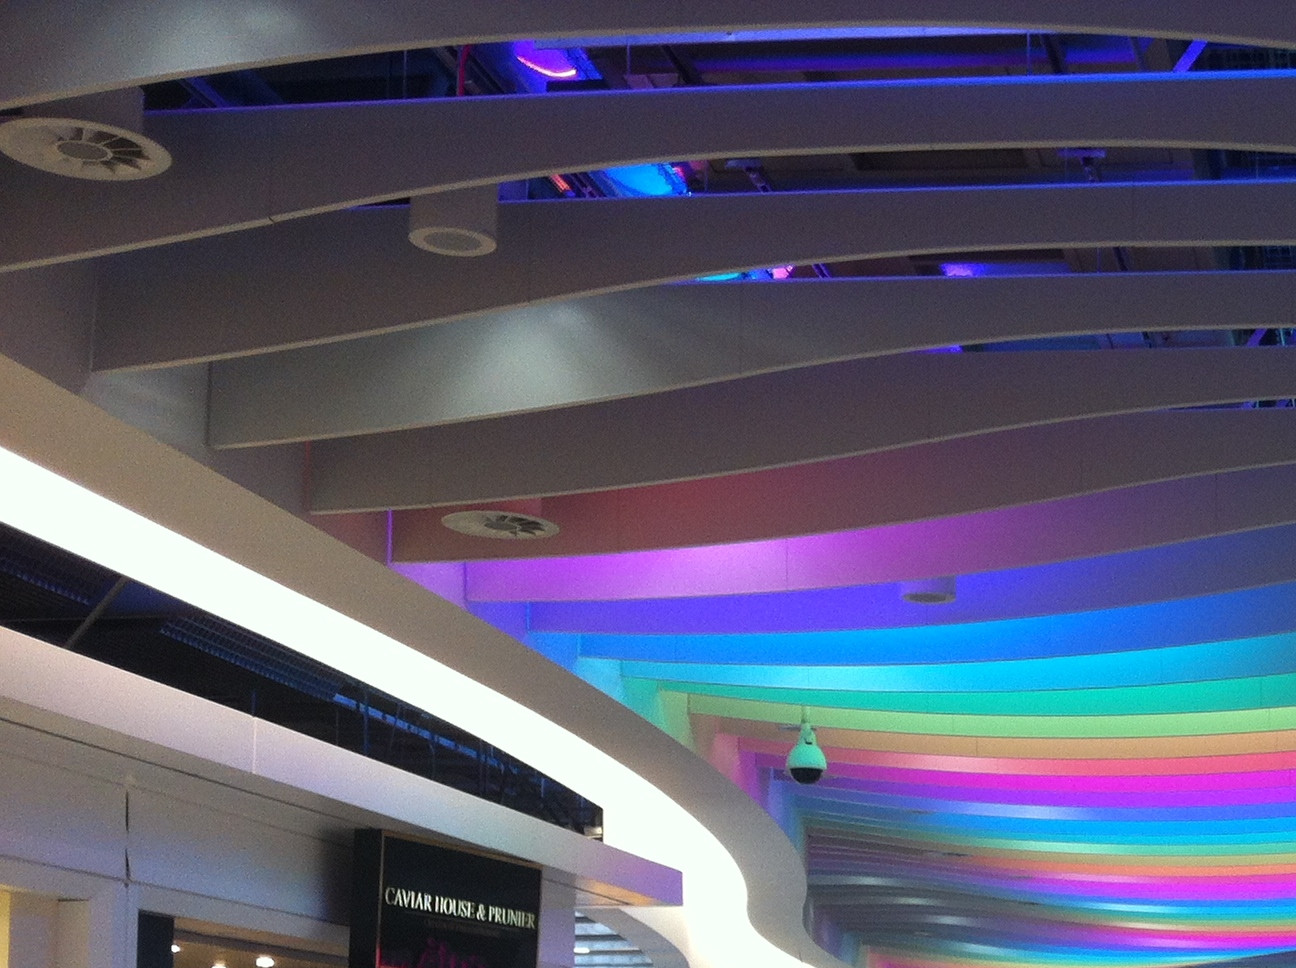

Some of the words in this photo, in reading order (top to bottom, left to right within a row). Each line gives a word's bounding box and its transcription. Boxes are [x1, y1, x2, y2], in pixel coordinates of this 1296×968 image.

[385, 887, 432, 912] CAVIAR
[434, 896, 476, 919] HOUSE
[476, 903, 487, 921] &
[488, 905, 536, 929] PRUNIER
